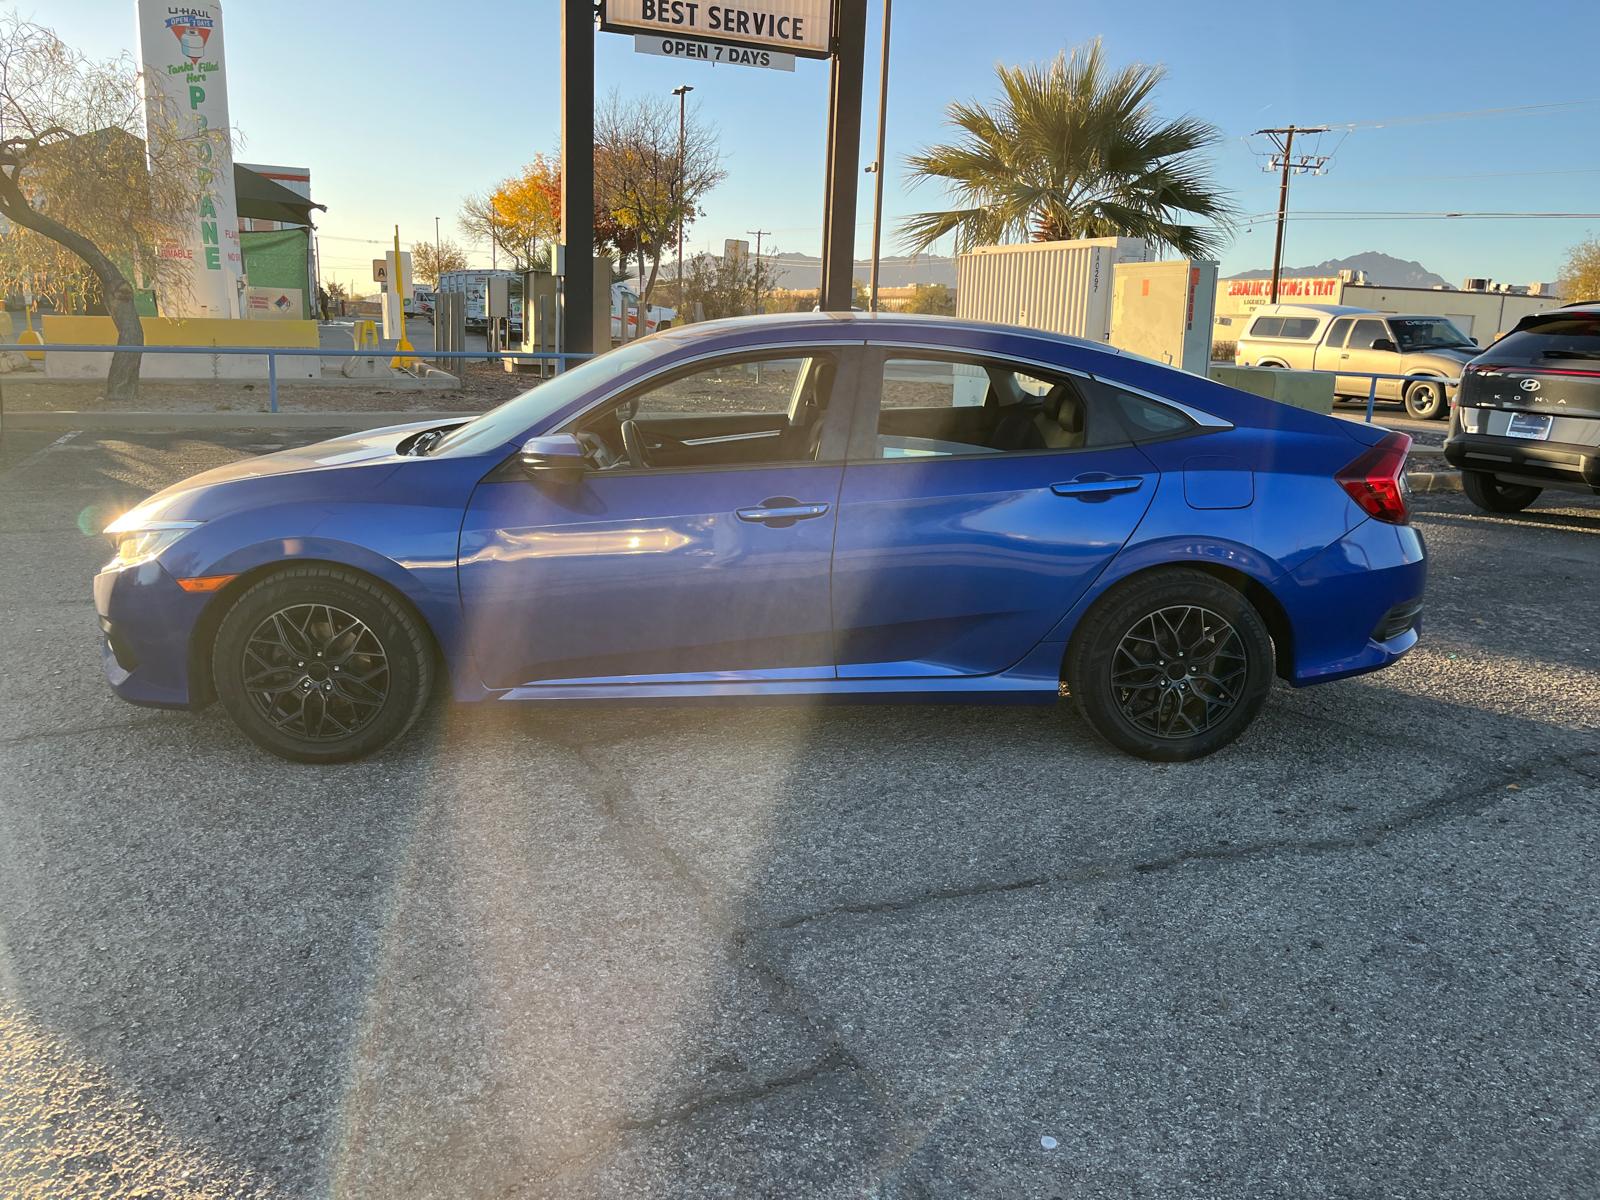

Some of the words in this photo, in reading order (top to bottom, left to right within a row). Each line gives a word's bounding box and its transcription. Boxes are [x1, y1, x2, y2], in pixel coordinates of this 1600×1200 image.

[168, 7, 211, 19] U-HAUL
[170, 17, 189, 25] OPEN
[641, 0, 699, 26] BEST
[708, 6, 804, 41] SERVICE
[661, 39, 708, 59] OPEN
[714, 46, 723, 61] 7
[728, 48, 770, 66] DAYS
[167, 62, 194, 75] Tanks
[198, 61, 219, 73] Filled
[186, 73, 206, 83] Here
[189, 86, 221, 270] PROPANE
[1494, 394, 1567, 404] KONA
